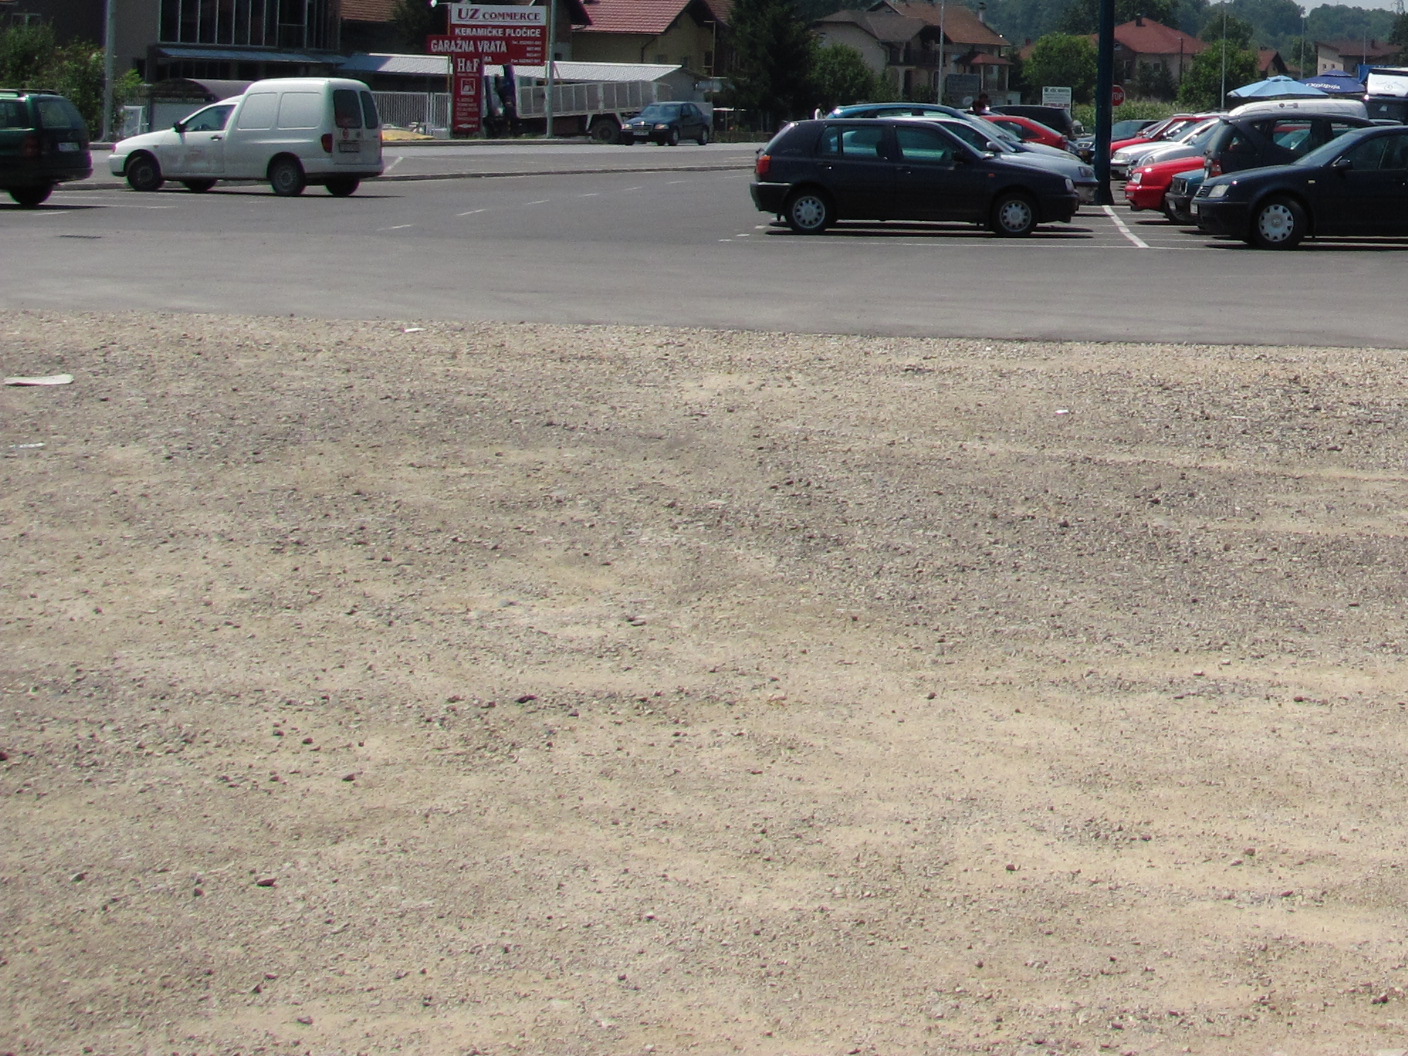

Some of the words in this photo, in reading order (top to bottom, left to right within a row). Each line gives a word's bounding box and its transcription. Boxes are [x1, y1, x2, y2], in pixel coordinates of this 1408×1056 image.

[457, 7, 480, 20] UZ
[482, 11, 541, 21] COMMERCE
[455, 26, 503, 37] KERAMIČKE
[431, 37, 475, 53] GARAŽNA
[478, 40, 507, 53] VRATA
[1111, 91, 1124, 101] TOP
